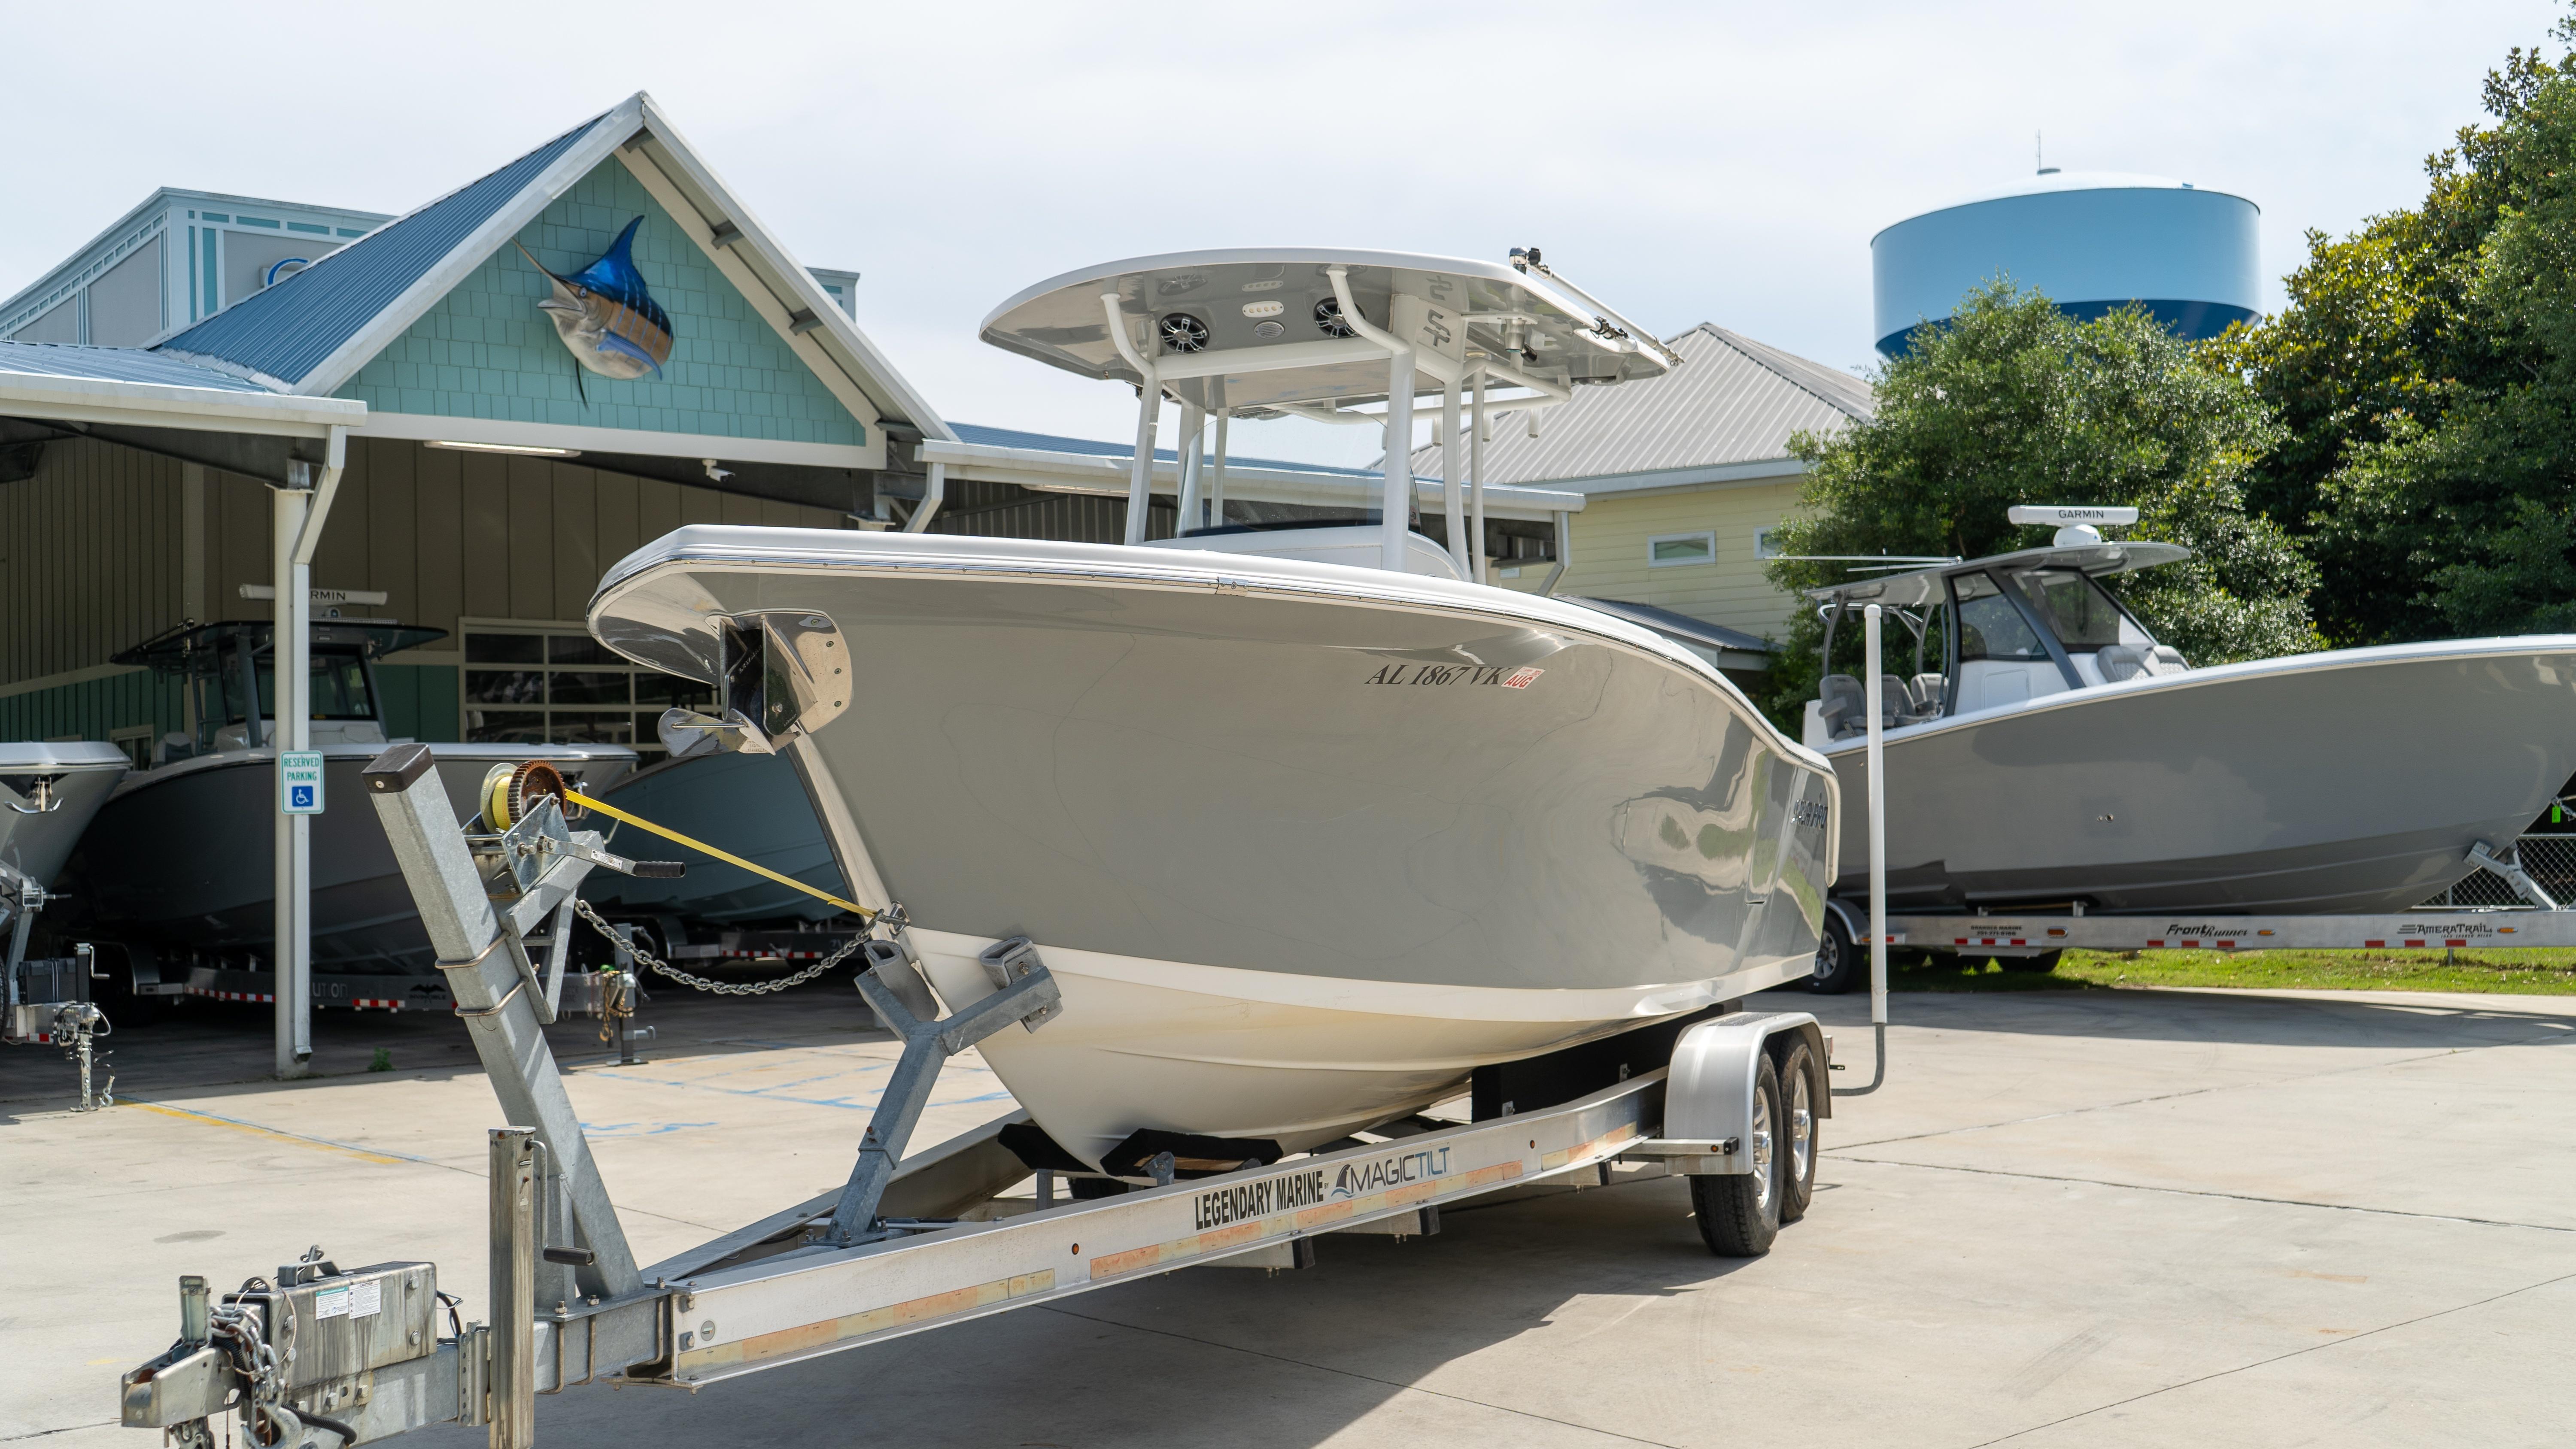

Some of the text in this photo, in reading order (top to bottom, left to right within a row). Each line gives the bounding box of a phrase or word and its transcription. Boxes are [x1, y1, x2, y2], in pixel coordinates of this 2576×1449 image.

[2059, 509, 2104, 518] GARMIN
[310, 591, 346, 600] RMIN
[1364, 664, 1514, 685] AL 1867 VK
[1504, 674, 1533, 688] AUG
[284, 757, 319, 767] RESERVED
[287, 771, 317, 782] PARKING
[1195, 1180, 1272, 1231] LEGENDARY
[1276, 1170, 1323, 1211] MARINE
[1351, 1147, 1450, 1194] MAGICTILT
